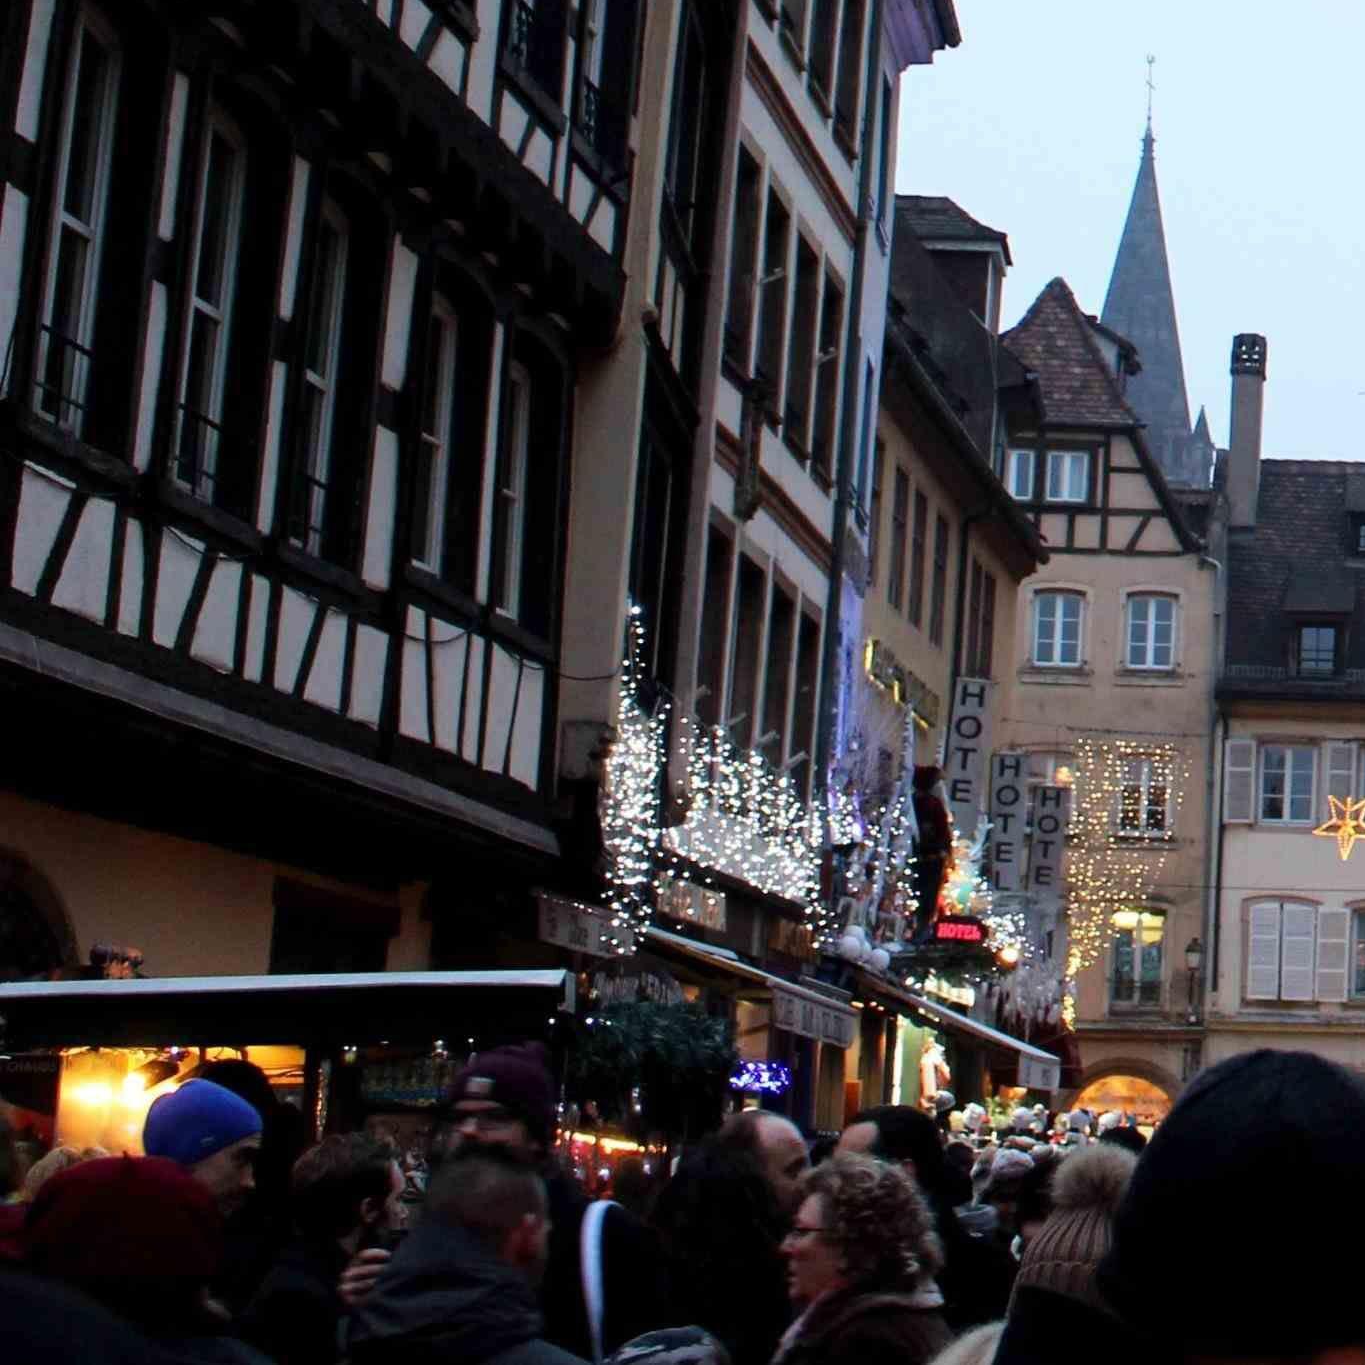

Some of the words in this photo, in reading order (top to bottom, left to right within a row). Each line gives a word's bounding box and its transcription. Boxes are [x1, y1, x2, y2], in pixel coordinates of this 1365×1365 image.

[950, 685, 986, 804] HOTE
[995, 756, 1021, 893] HOTEL
[1034, 787, 1061, 887] HOTE
[937, 922, 981, 940] HOTEL
